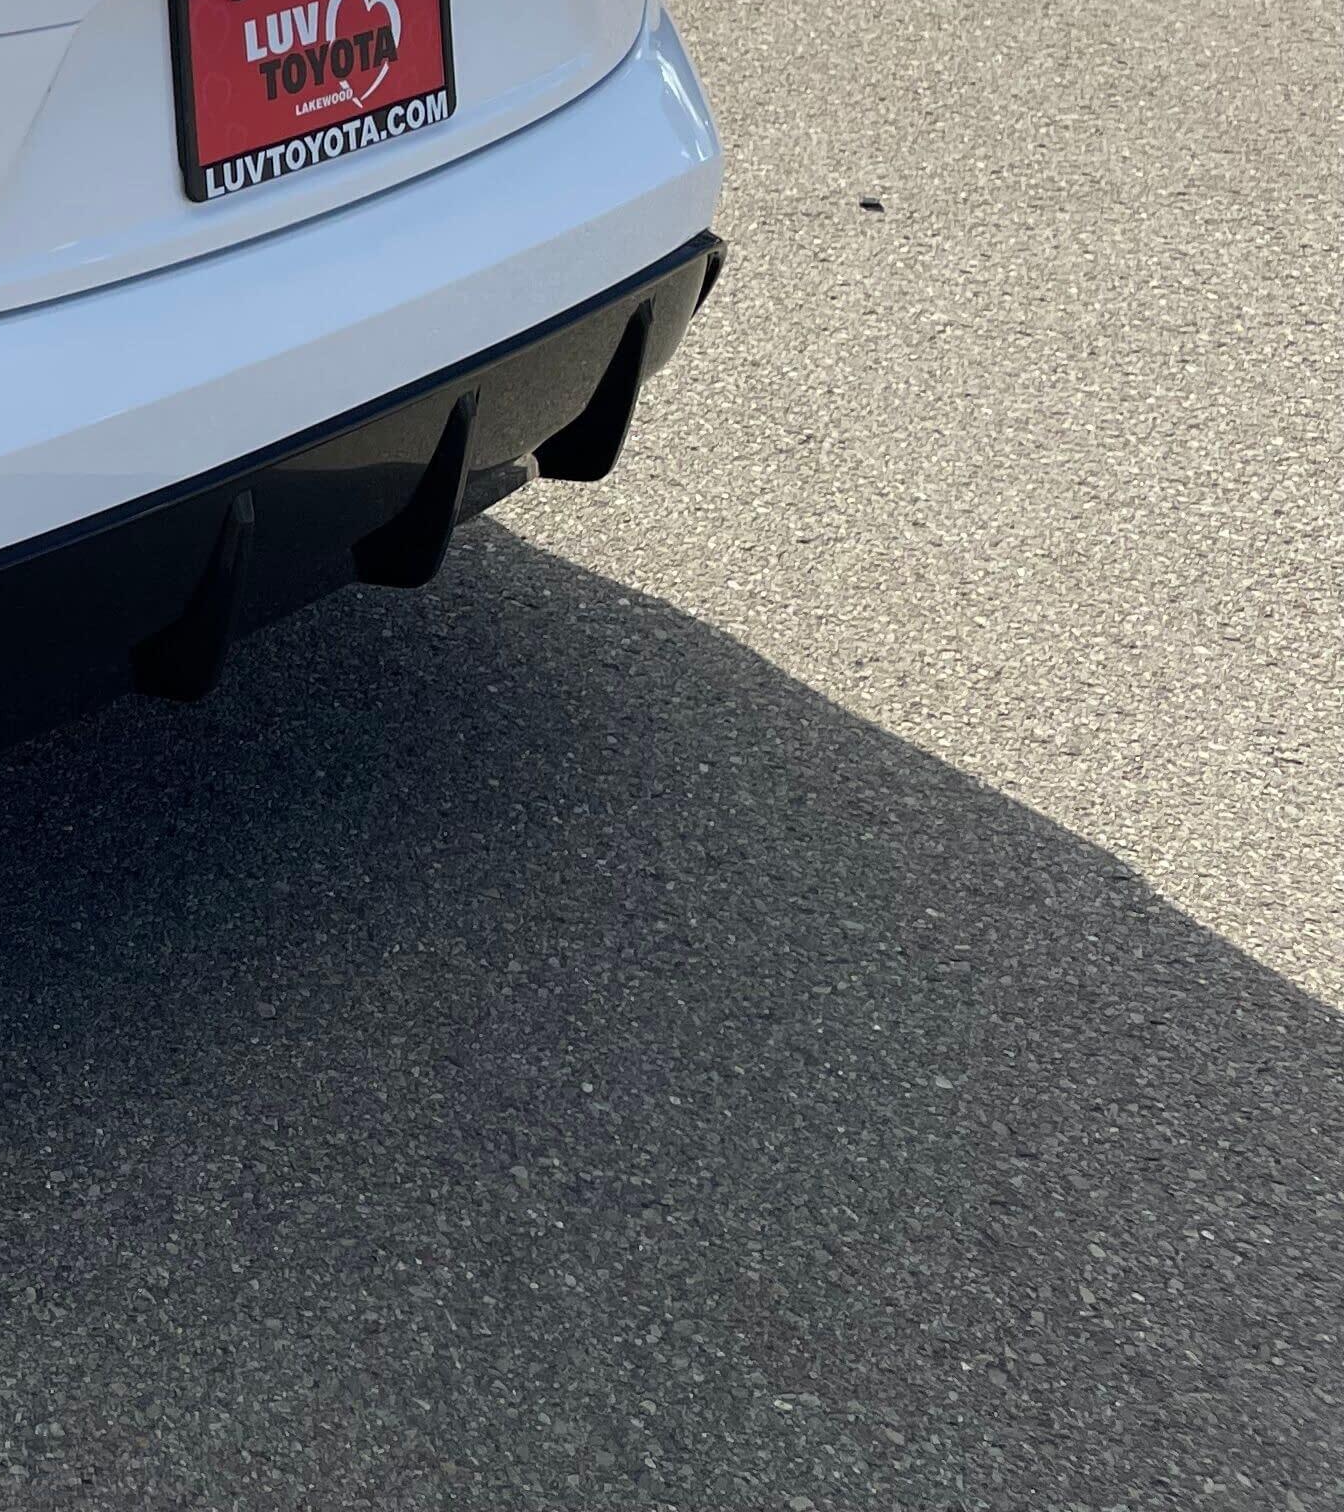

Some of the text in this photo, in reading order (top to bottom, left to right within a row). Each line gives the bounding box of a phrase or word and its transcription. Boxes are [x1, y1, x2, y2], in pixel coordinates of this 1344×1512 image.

[244, 1, 320, 63] LUV
[259, 25, 399, 101] TOYOTA
[294, 88, 354, 117] LAKEWOOD
[205, 90, 449, 198] LUVTOYOTA.COM
